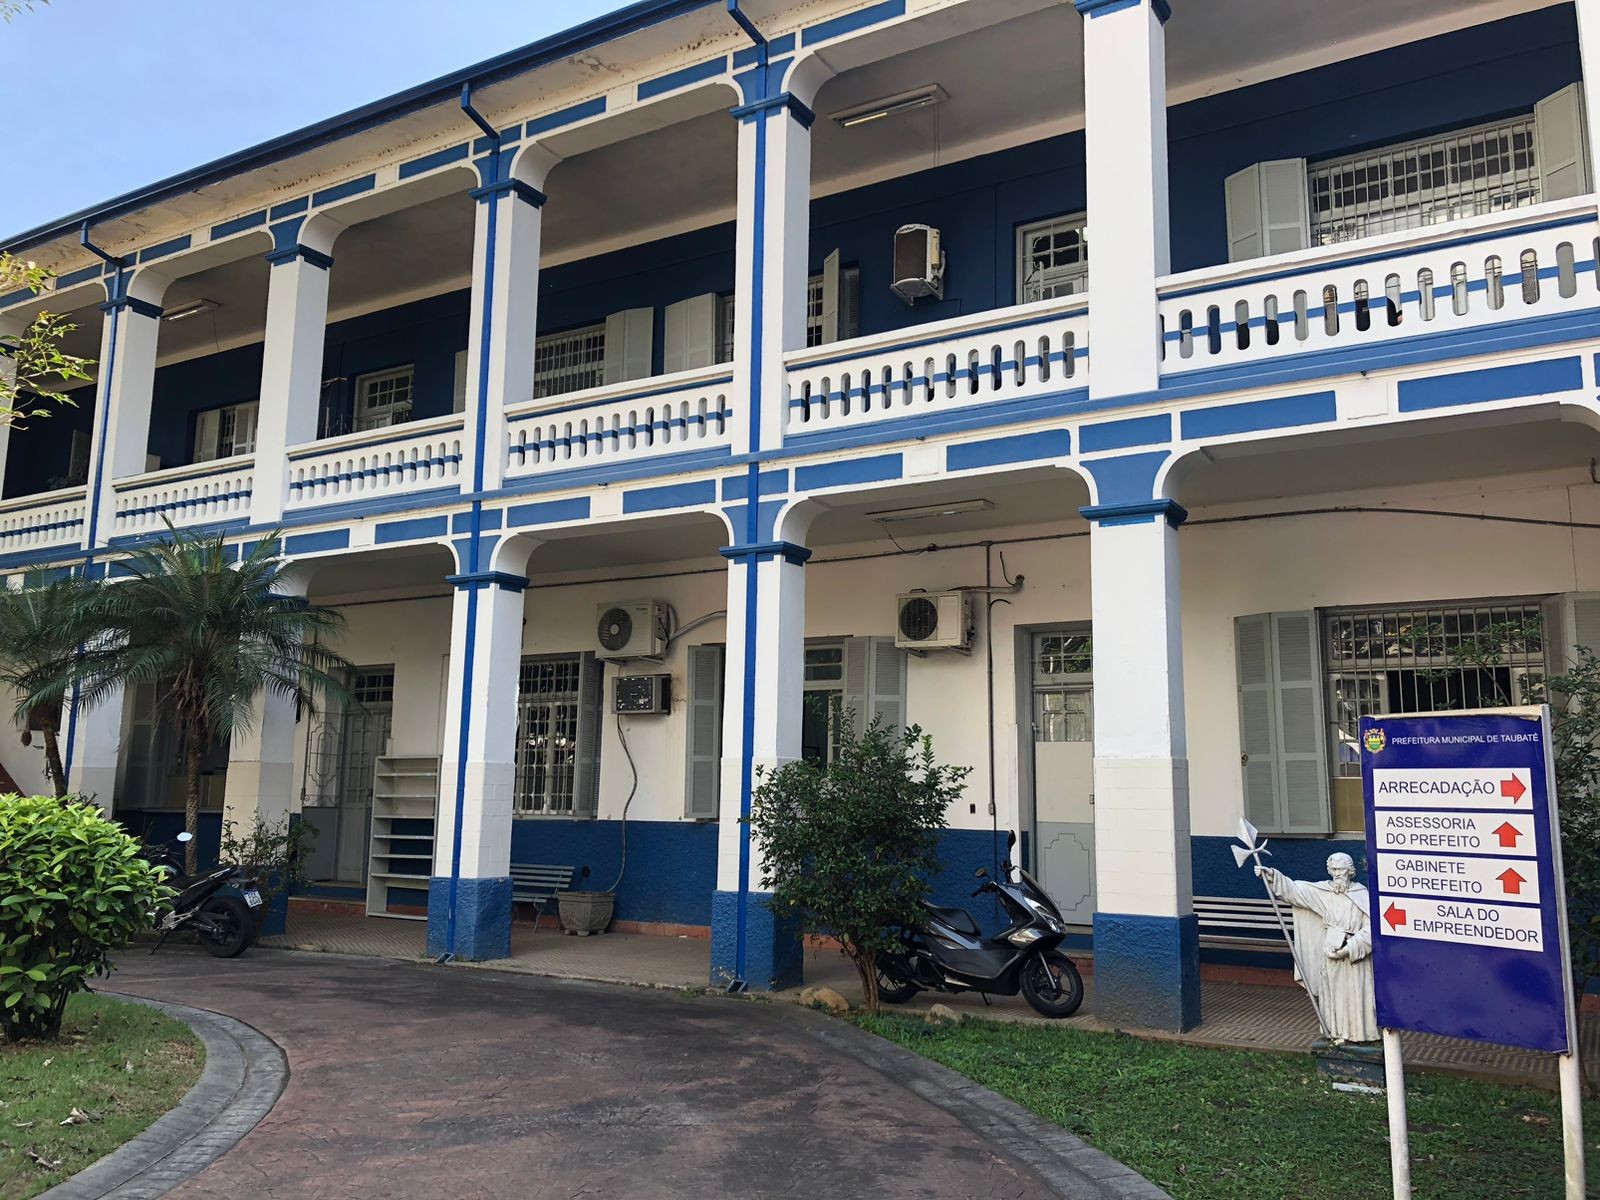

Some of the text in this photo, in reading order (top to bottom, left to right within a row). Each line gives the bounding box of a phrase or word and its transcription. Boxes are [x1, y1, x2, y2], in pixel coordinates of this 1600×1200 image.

[1391, 732, 1539, 745] PREFEITURA MUNICIPAL DE TAUBATÉ
[1378, 779, 1496, 798] ARRECADAÇÃO
[1386, 816, 1476, 831] ASSESSORIA
[1386, 833, 1480, 848] DO PREFEITO
[1395, 859, 1466, 875] GABINETE
[1387, 875, 1483, 894] DO PREFEITO
[1436, 904, 1500, 922] SALA DO
[1413, 919, 1539, 943] EMPREENDEDOR
